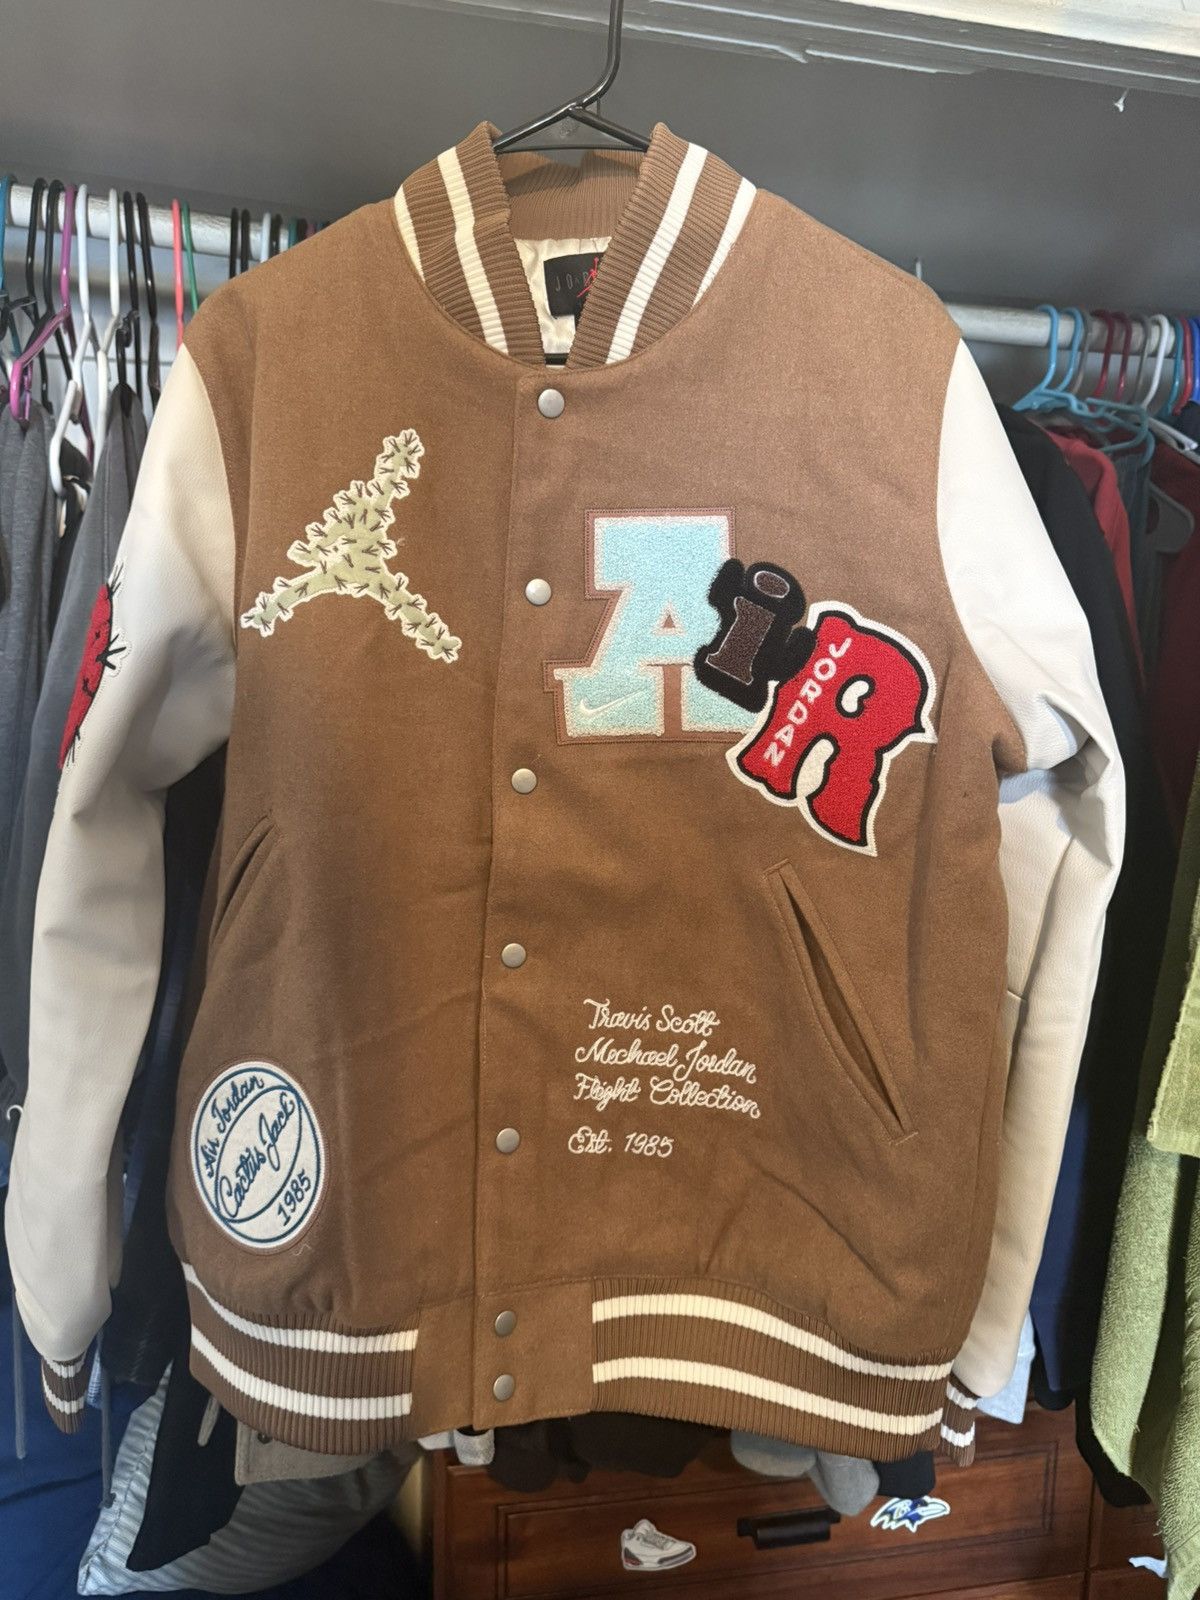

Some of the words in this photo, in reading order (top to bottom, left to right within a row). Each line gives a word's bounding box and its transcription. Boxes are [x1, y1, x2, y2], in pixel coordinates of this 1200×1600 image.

[762, 637, 852, 768] JORDAN
[583, 998, 652, 1031] Travis
[655, 1004, 721, 1037] Scott
[574, 1037, 680, 1067] Michael
[673, 1040, 757, 1084] Jordan
[573, 1073, 641, 1112] Flight
[649, 1075, 761, 1119] Collection
[200, 1137, 220, 1179] Air
[211, 1075, 264, 1134] Jordan
[567, 1126, 613, 1154] Est.
[624, 1132, 674, 1158] 1985
[219, 1146, 268, 1218] Cactus
[259, 1091, 296, 1172] Jack
[277, 1168, 311, 1226] 1985
